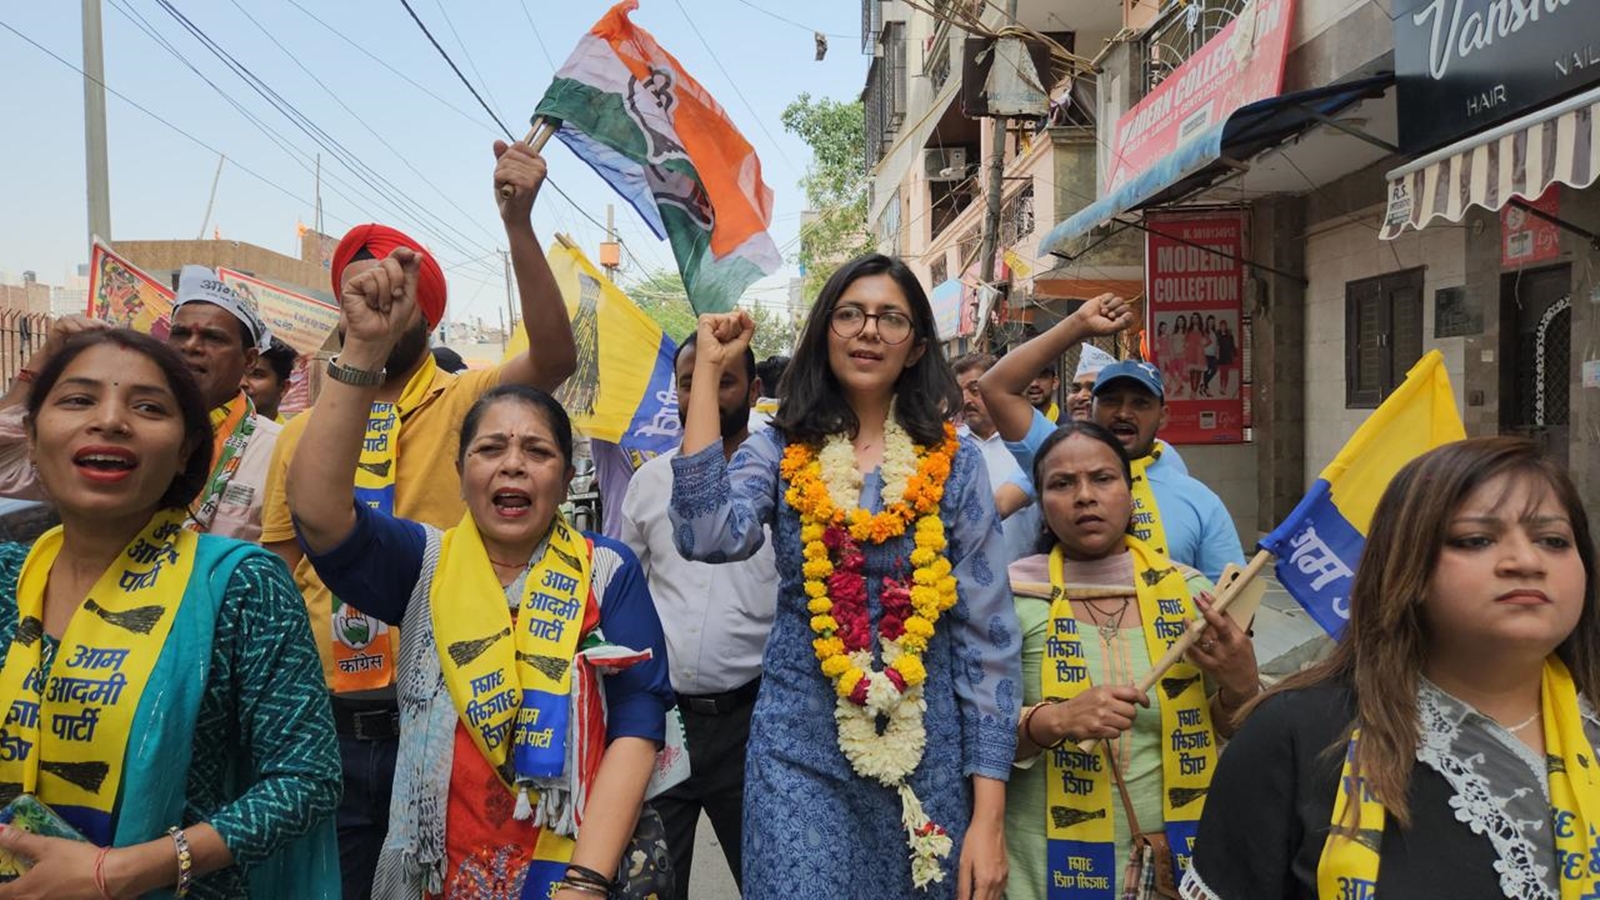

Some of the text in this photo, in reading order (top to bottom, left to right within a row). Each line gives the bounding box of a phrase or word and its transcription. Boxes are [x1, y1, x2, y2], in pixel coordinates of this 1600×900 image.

[1174, 0, 1281, 105] COLLECON
[1467, 85, 1508, 116] HAIR
[1157, 244, 1235, 273] MODERN
[1154, 276, 1238, 302] COLLECTION
[541, 569, 579, 595] आम
[526, 592, 581, 620] आदमी
[528, 618, 565, 642] पार्टी
[66, 645, 130, 671] आम
[338, 653, 383, 673] कांग्रेस
[46, 672, 127, 705] आदमी
[52, 707, 101, 742] पार्टी
[527, 728, 554, 749] पार्टी
